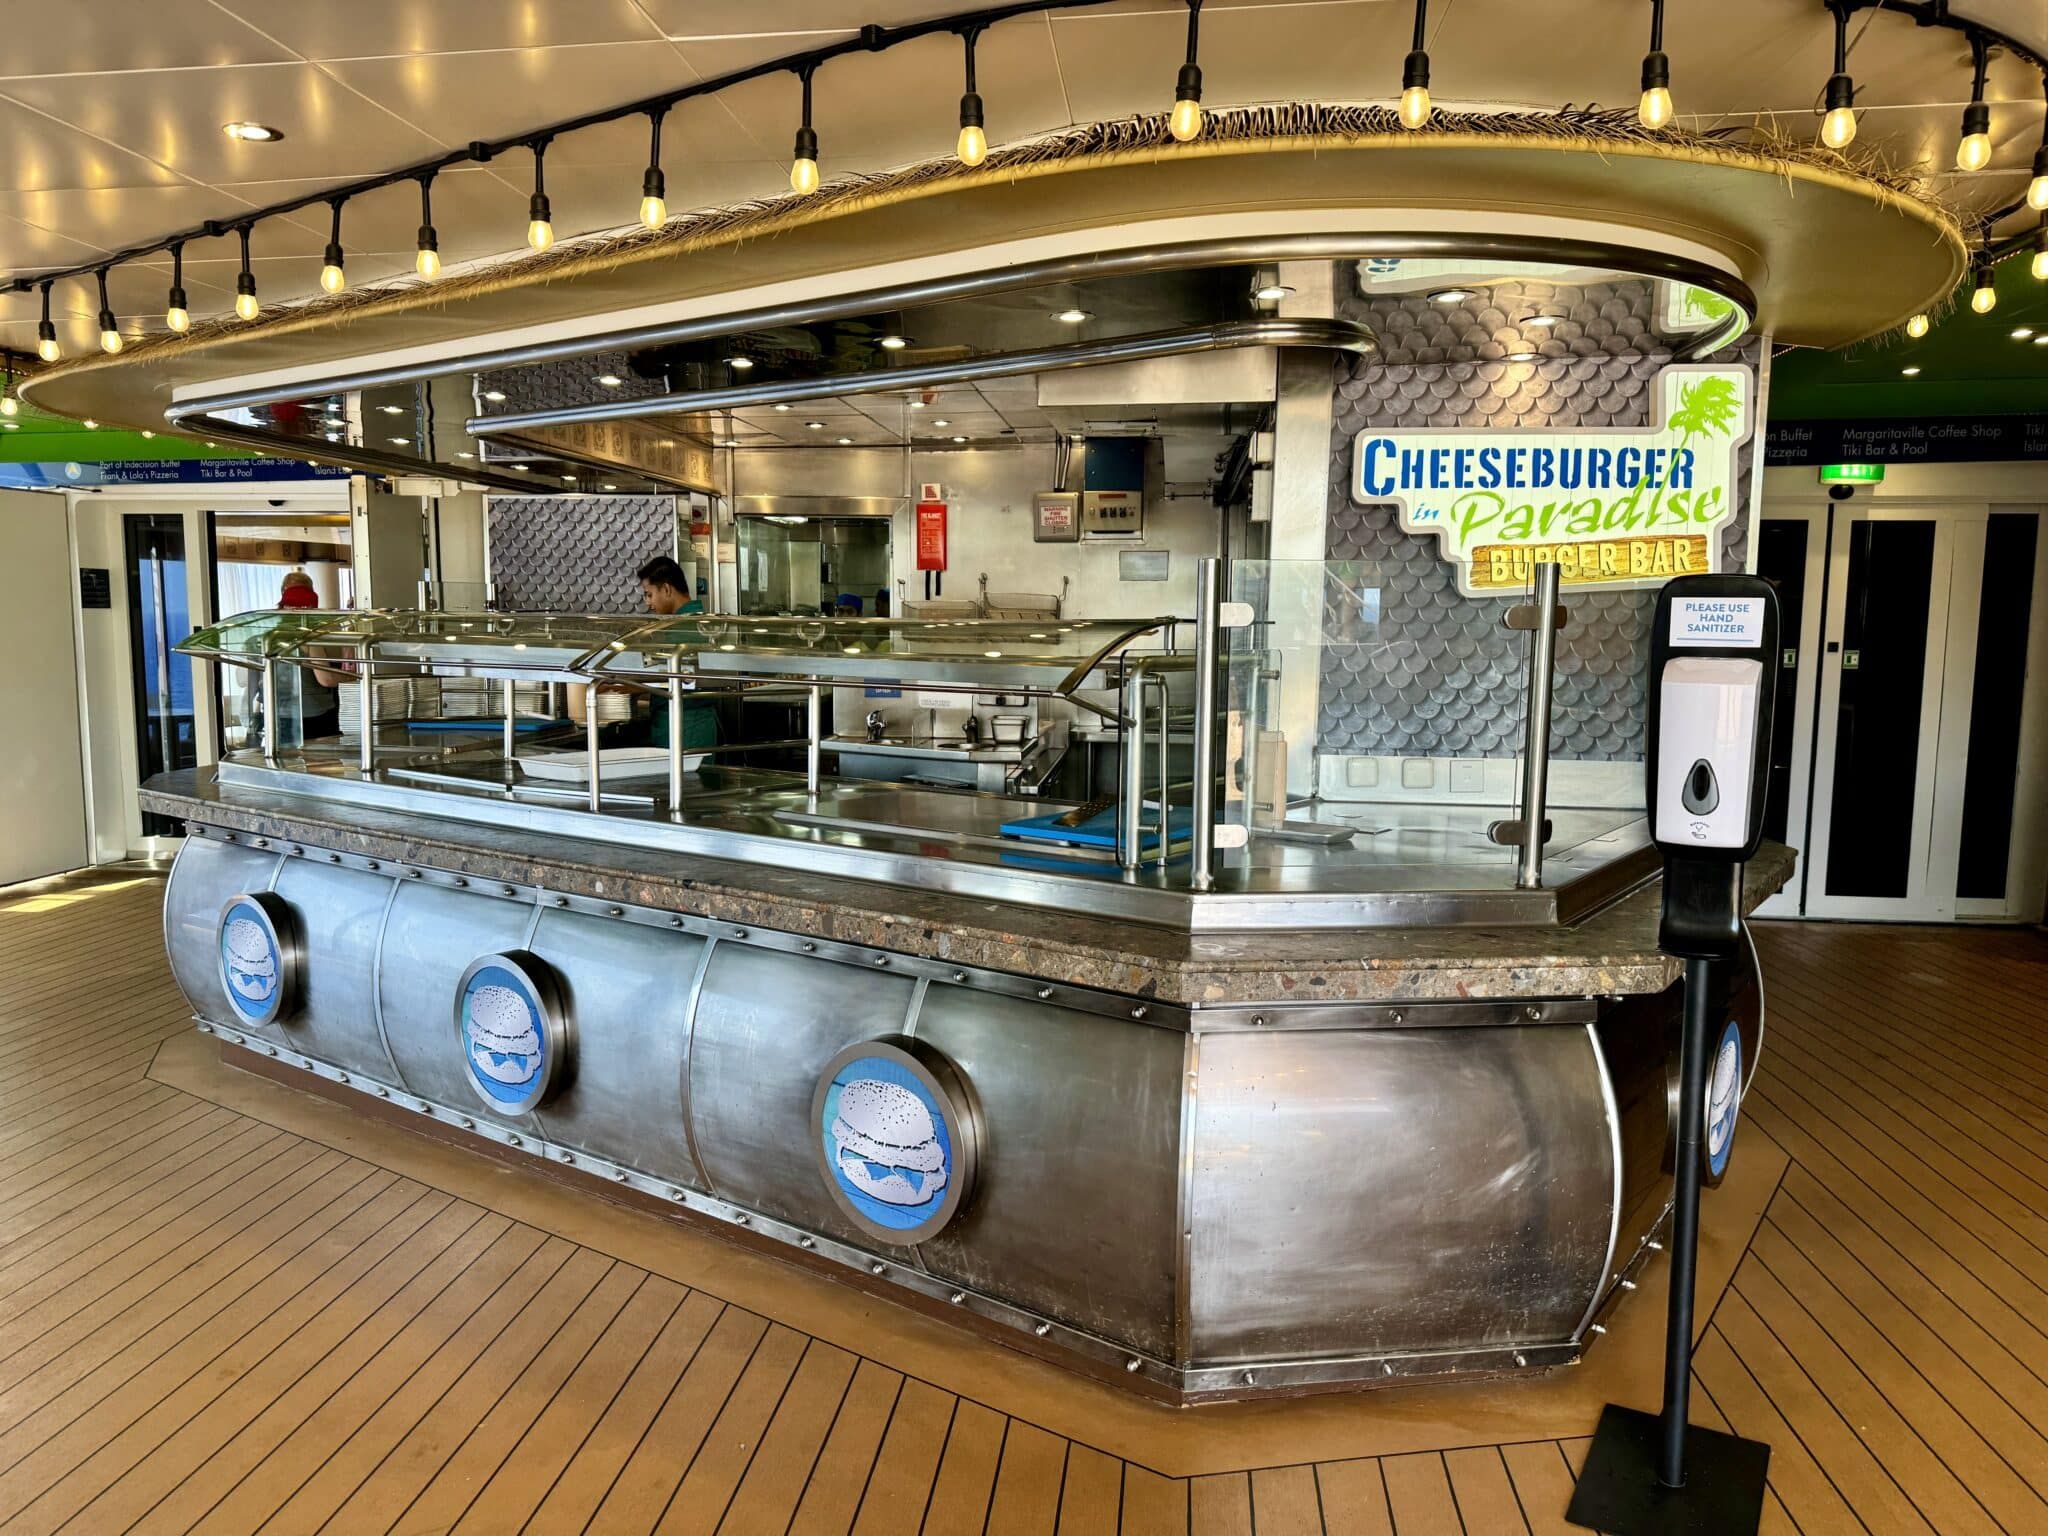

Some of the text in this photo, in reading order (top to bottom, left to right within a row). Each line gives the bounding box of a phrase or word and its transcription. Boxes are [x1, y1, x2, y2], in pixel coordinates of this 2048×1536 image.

[1781, 428, 1813, 441] Buffet
[1842, 423, 2002, 443] Margaritaville Coffee Shop
[1842, 441, 1928, 456] Tiki Bar & Pool
[200, 458, 296, 469] Margaritaville Coffee Shop
[1363, 438, 1695, 497] CHEESEBURGER
[100, 471, 119, 480] Frank
[129, 470, 149, 479] Lola's
[151, 469, 179, 479] Pizzeria
[200, 468, 253, 478] Tiki Bar & Pool
[1412, 502, 1440, 521] in
[1450, 474, 1726, 547] Paradise
[1629, 539, 1692, 575] BAR
[1685, 603, 1750, 613] PLEASE USE
[1700, 614, 1734, 623] HAND
[1687, 623, 1745, 633] SANITIZER
